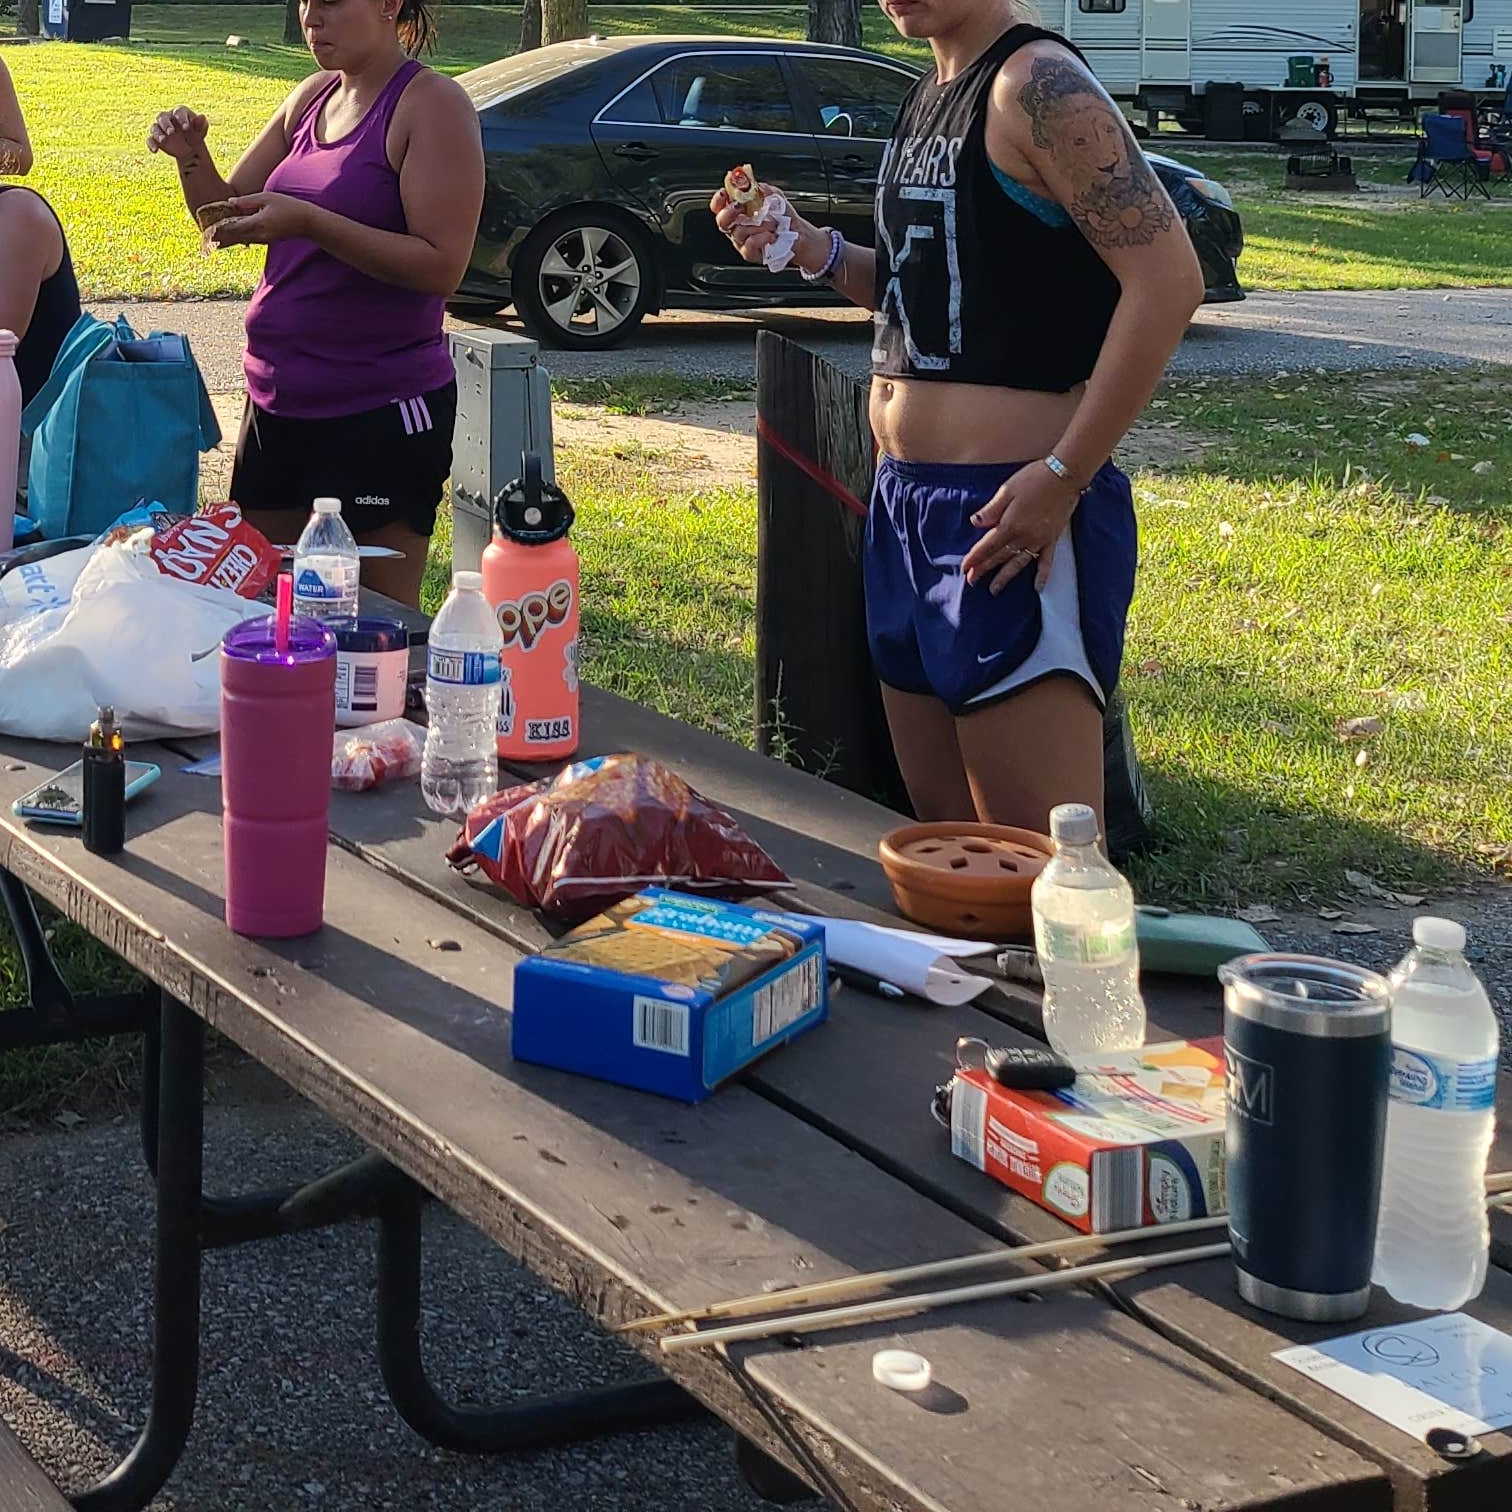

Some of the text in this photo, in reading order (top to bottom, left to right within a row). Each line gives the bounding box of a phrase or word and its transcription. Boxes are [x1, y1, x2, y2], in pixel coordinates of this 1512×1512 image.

[891, 135, 962, 186] YEARS
[355, 495, 390, 506] adidas
[298, 583, 324, 593] WATER
[528, 718, 571, 740] KISS
